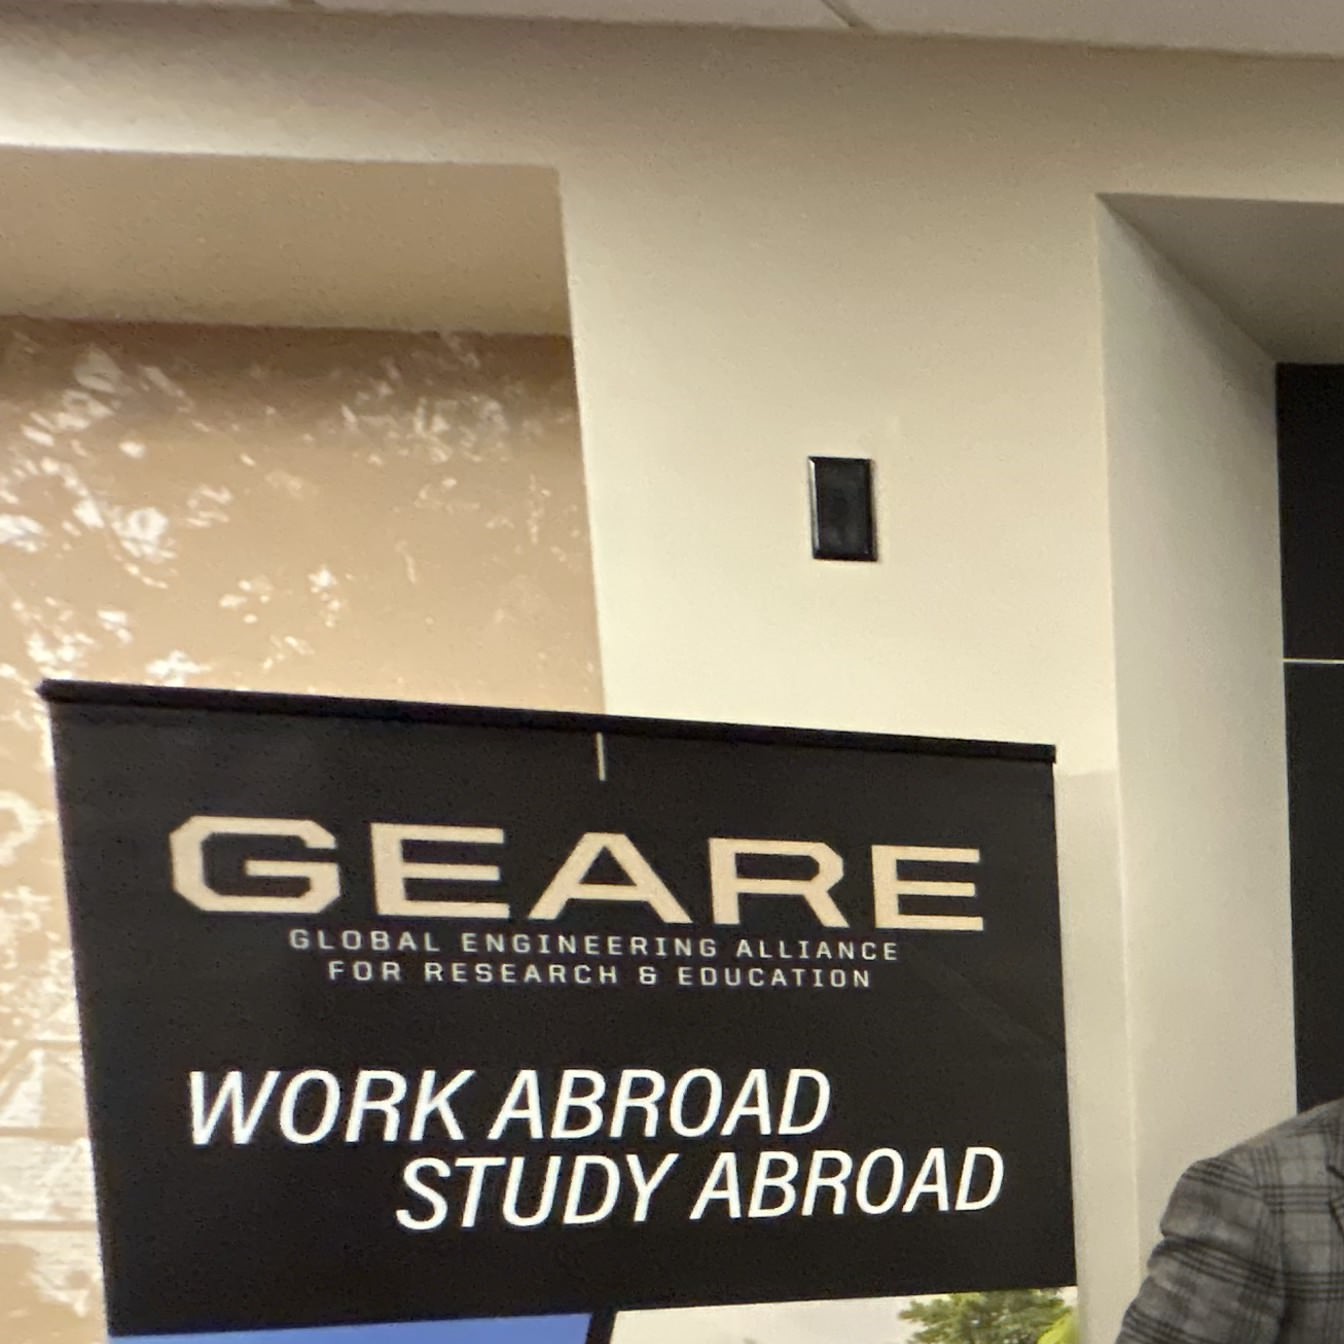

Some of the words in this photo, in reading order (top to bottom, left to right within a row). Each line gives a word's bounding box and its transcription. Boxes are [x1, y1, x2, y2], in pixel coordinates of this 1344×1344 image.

[169, 815, 985, 933] GEARE
[289, 928, 441, 953] GLOBAL
[461, 932, 718, 959] ENGINEERING
[736, 938, 899, 963] ALLIANCE
[329, 960, 402, 983] FOR
[425, 961, 618, 986] RESEARCH
[638, 965, 658, 987] &
[678, 966, 872, 990] EDUCATION
[189, 1069, 476, 1145] WORK
[488, 1067, 832, 1142] ABROAD
[395, 1154, 679, 1232] STUDY
[692, 1145, 1004, 1221] ABROAD
